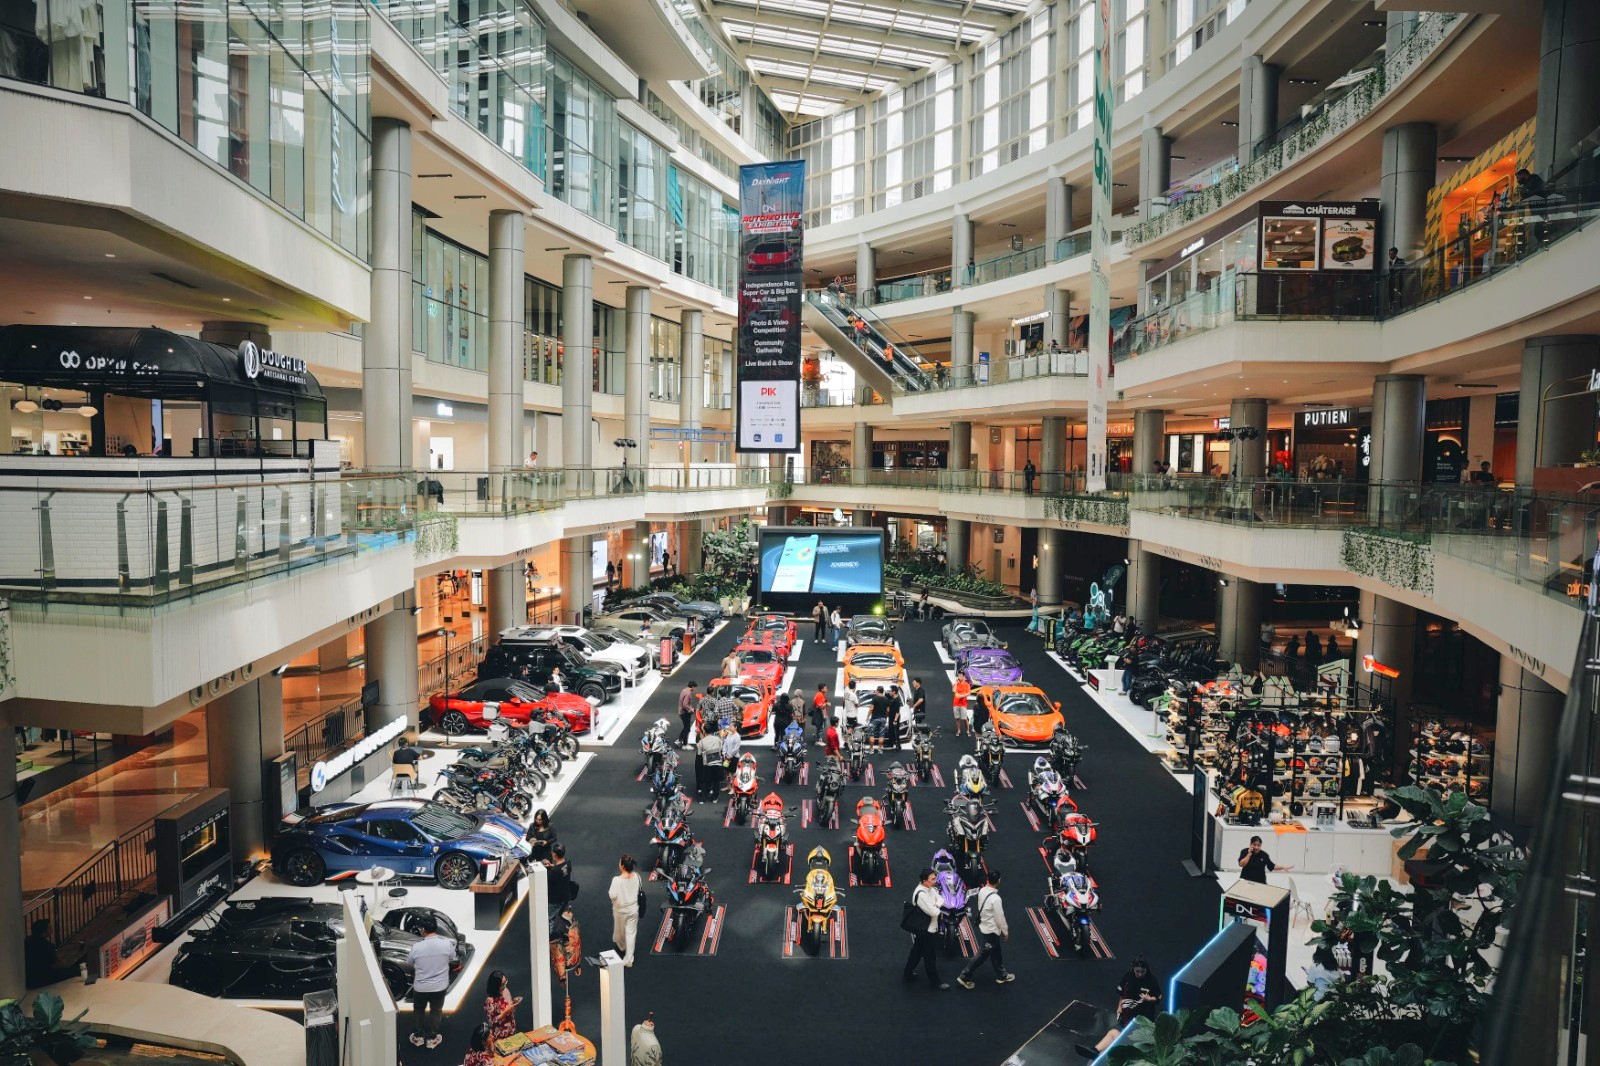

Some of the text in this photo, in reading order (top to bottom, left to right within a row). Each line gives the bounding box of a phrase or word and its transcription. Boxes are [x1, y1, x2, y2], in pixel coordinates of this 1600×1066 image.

[1306, 205, 1357, 215] CHÂTERAISÉ
[745, 281, 783, 289] Independence
[261, 348, 307, 374] DOUGH LAB
[761, 388, 777, 396] PIK
[1304, 410, 1348, 426] PUTIEN
